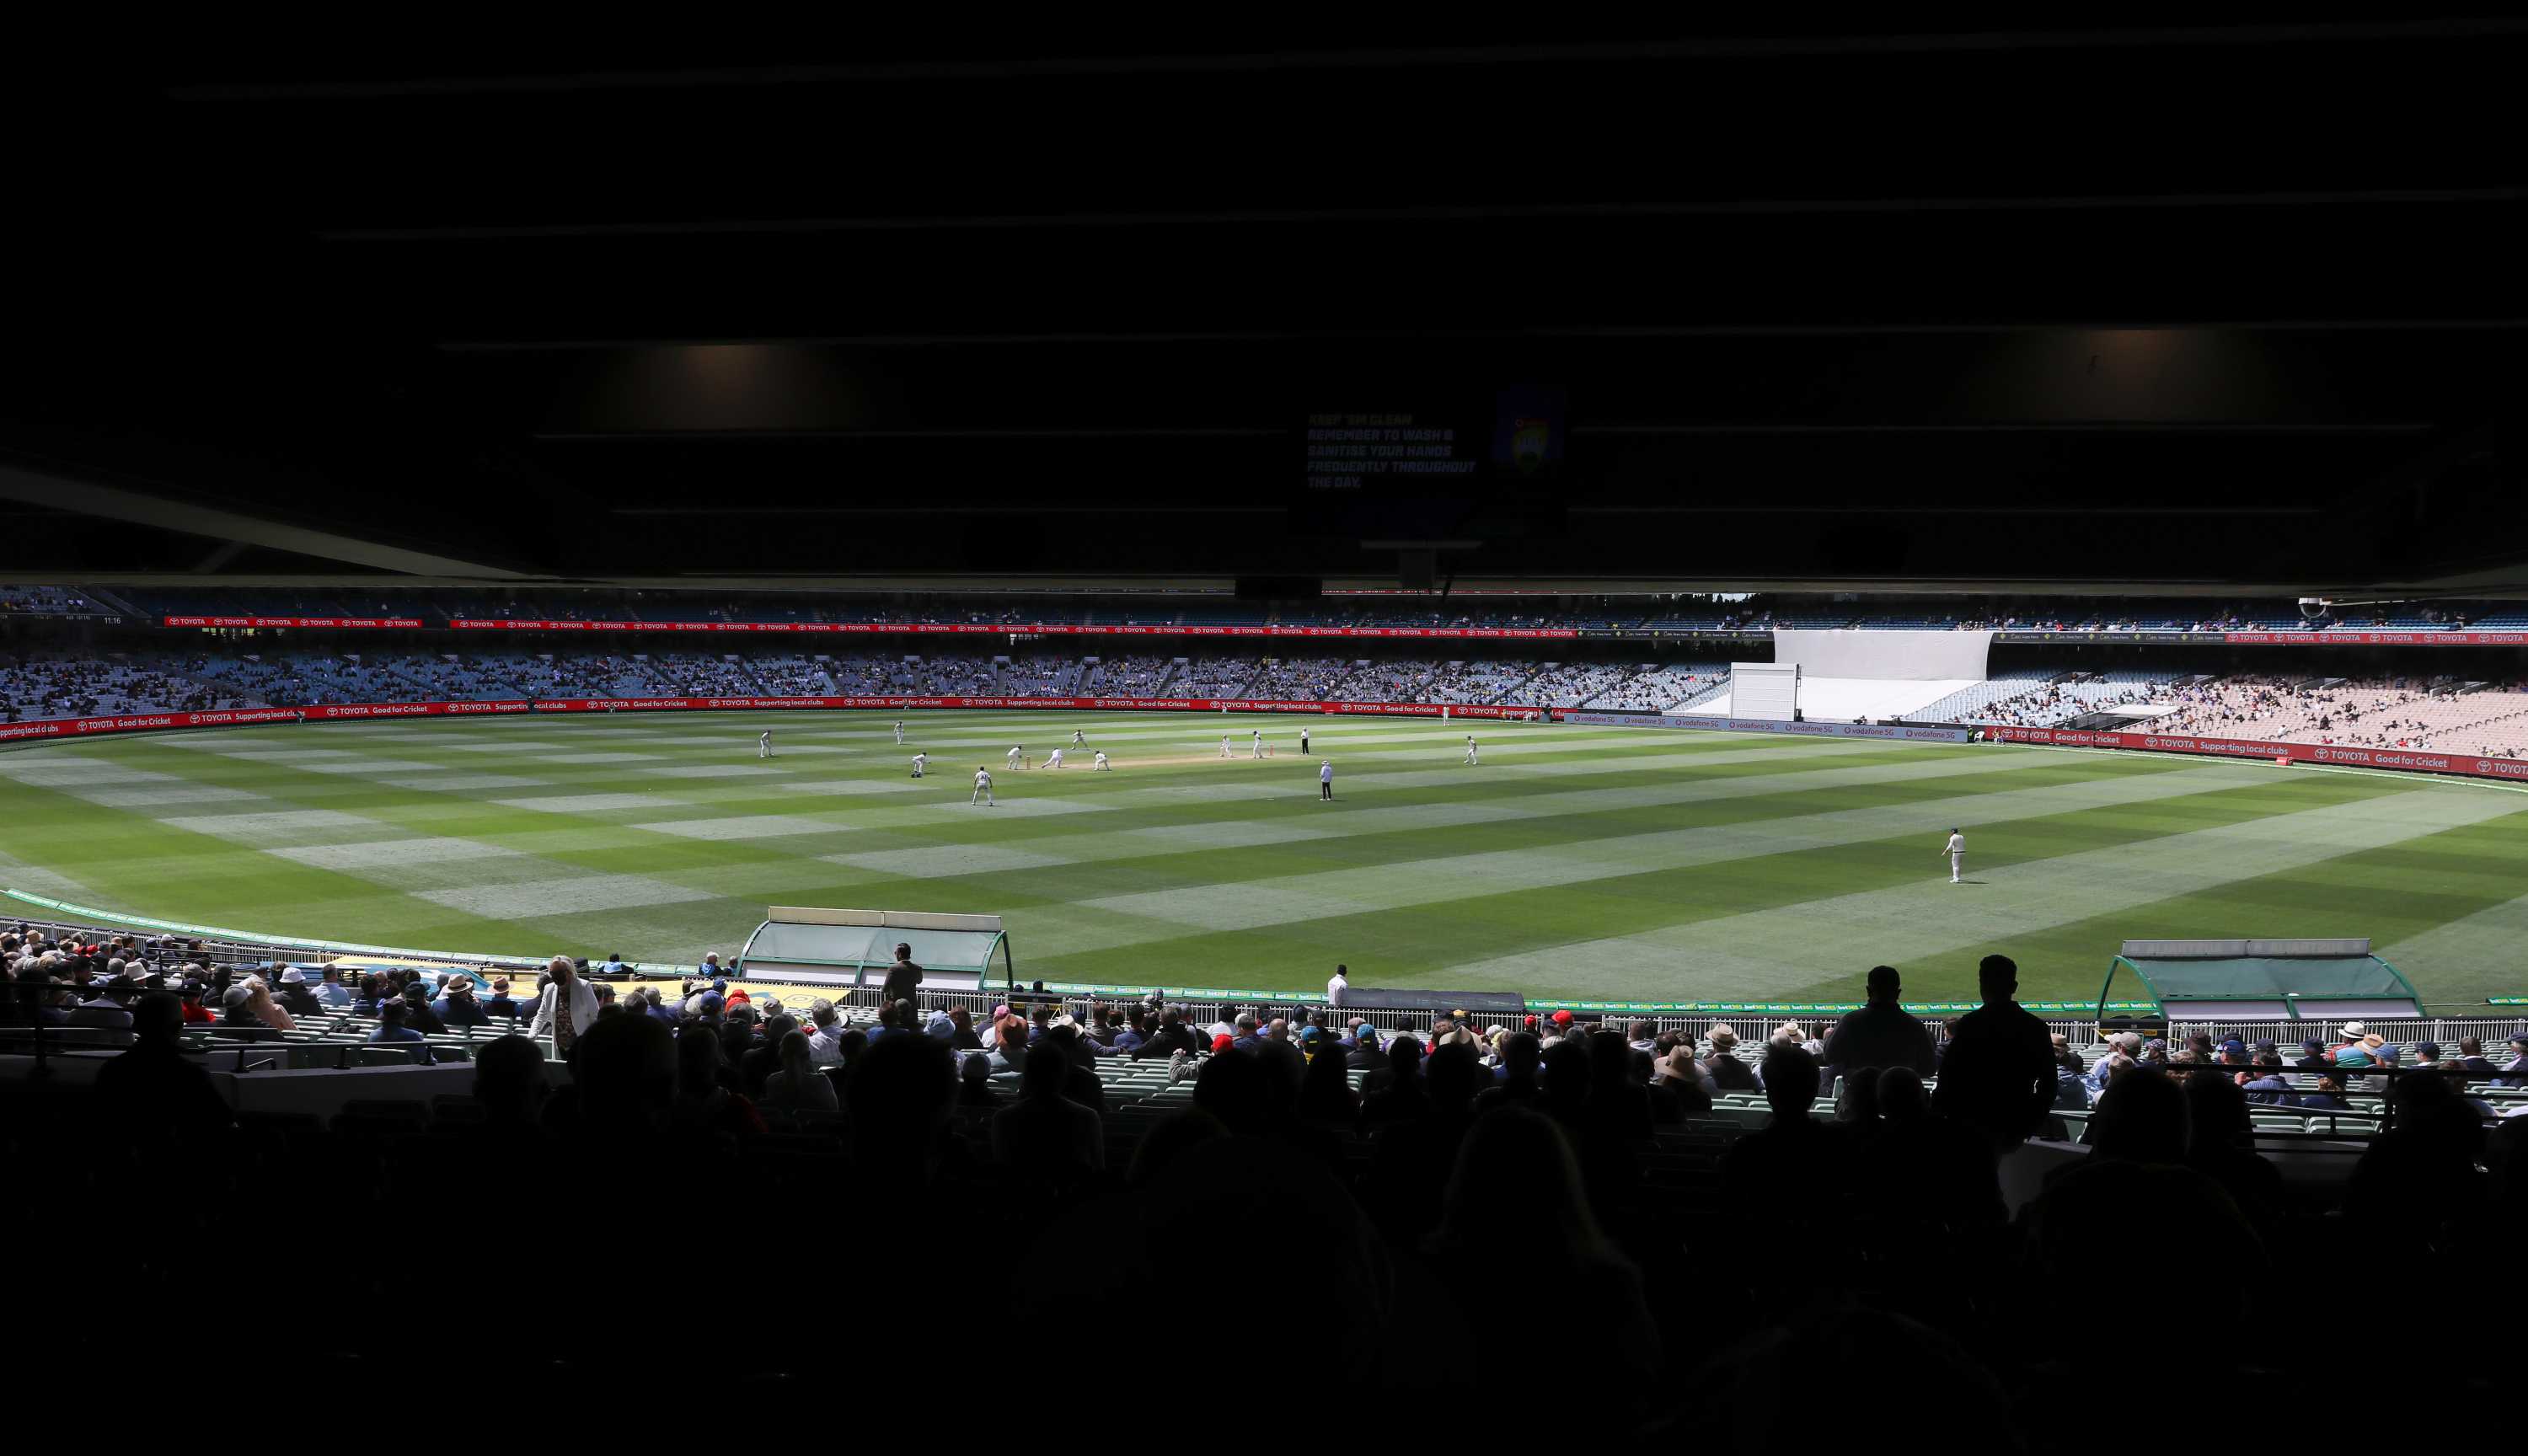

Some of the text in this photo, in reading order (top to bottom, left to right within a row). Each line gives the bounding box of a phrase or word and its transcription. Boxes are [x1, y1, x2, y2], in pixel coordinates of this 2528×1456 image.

[1385, 429, 1401, 441] TO
[1402, 429, 1441, 441] WASH
[1308, 445, 1451, 457] SANITISE YOUR HANDS
[1308, 461, 1476, 473] FREQUENTLY THROUGHOUT
[1309, 476, 1334, 488] THE
[754, 699, 790, 707] Supporting
[1006, 699, 1042, 707] Supporting
[236, 711, 270, 721] Supporting
[2056, 733, 2075, 741] Good
[2078, 734, 2091, 742] for
[2160, 739, 2194, 748] TOYOTA
[2247, 744, 2265, 754] local
[2268, 745, 2288, 756] clubs
[2332, 751, 2447, 768] TOYOTA Good for Cricket
[2494, 763, 2528, 774] TOYOT
